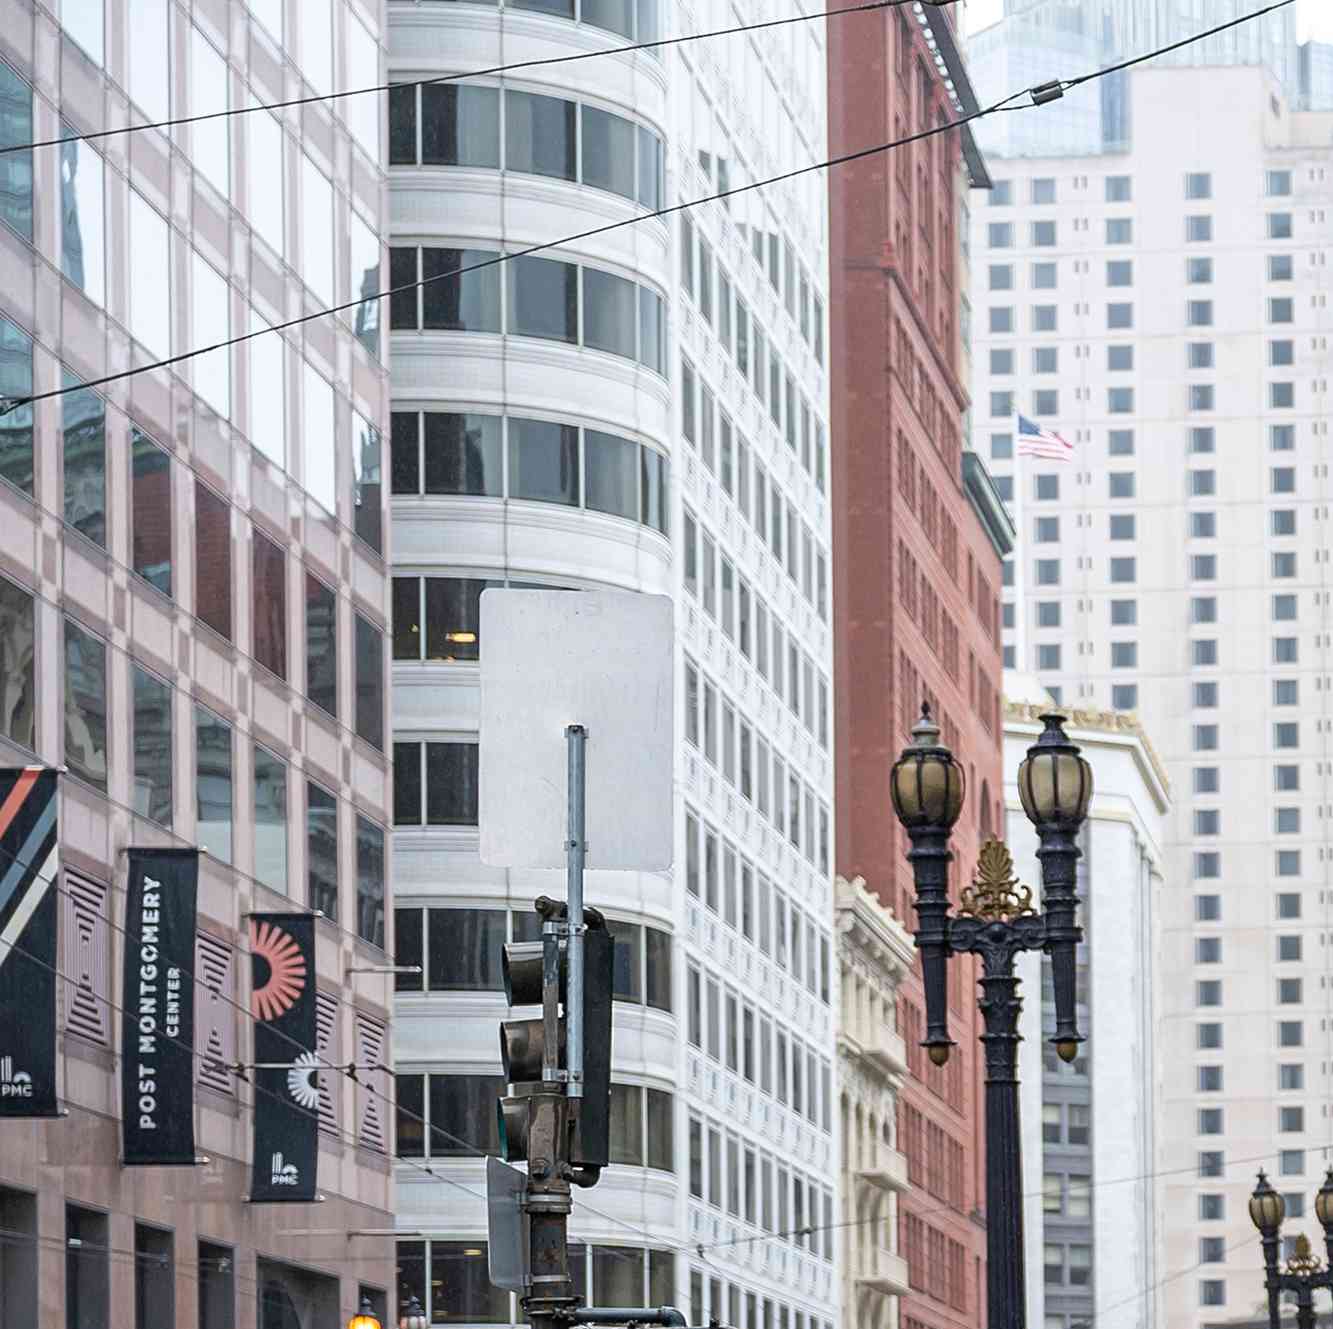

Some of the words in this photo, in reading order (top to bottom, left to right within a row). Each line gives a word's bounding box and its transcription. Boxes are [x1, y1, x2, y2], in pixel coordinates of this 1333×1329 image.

[138, 875, 161, 1053] MONTGOMERY
[166, 967, 181, 1038] CENTER
[2, 1084, 33, 1097] PMC
[138, 1063, 157, 1130] POST
[272, 1174, 299, 1186] PMC
